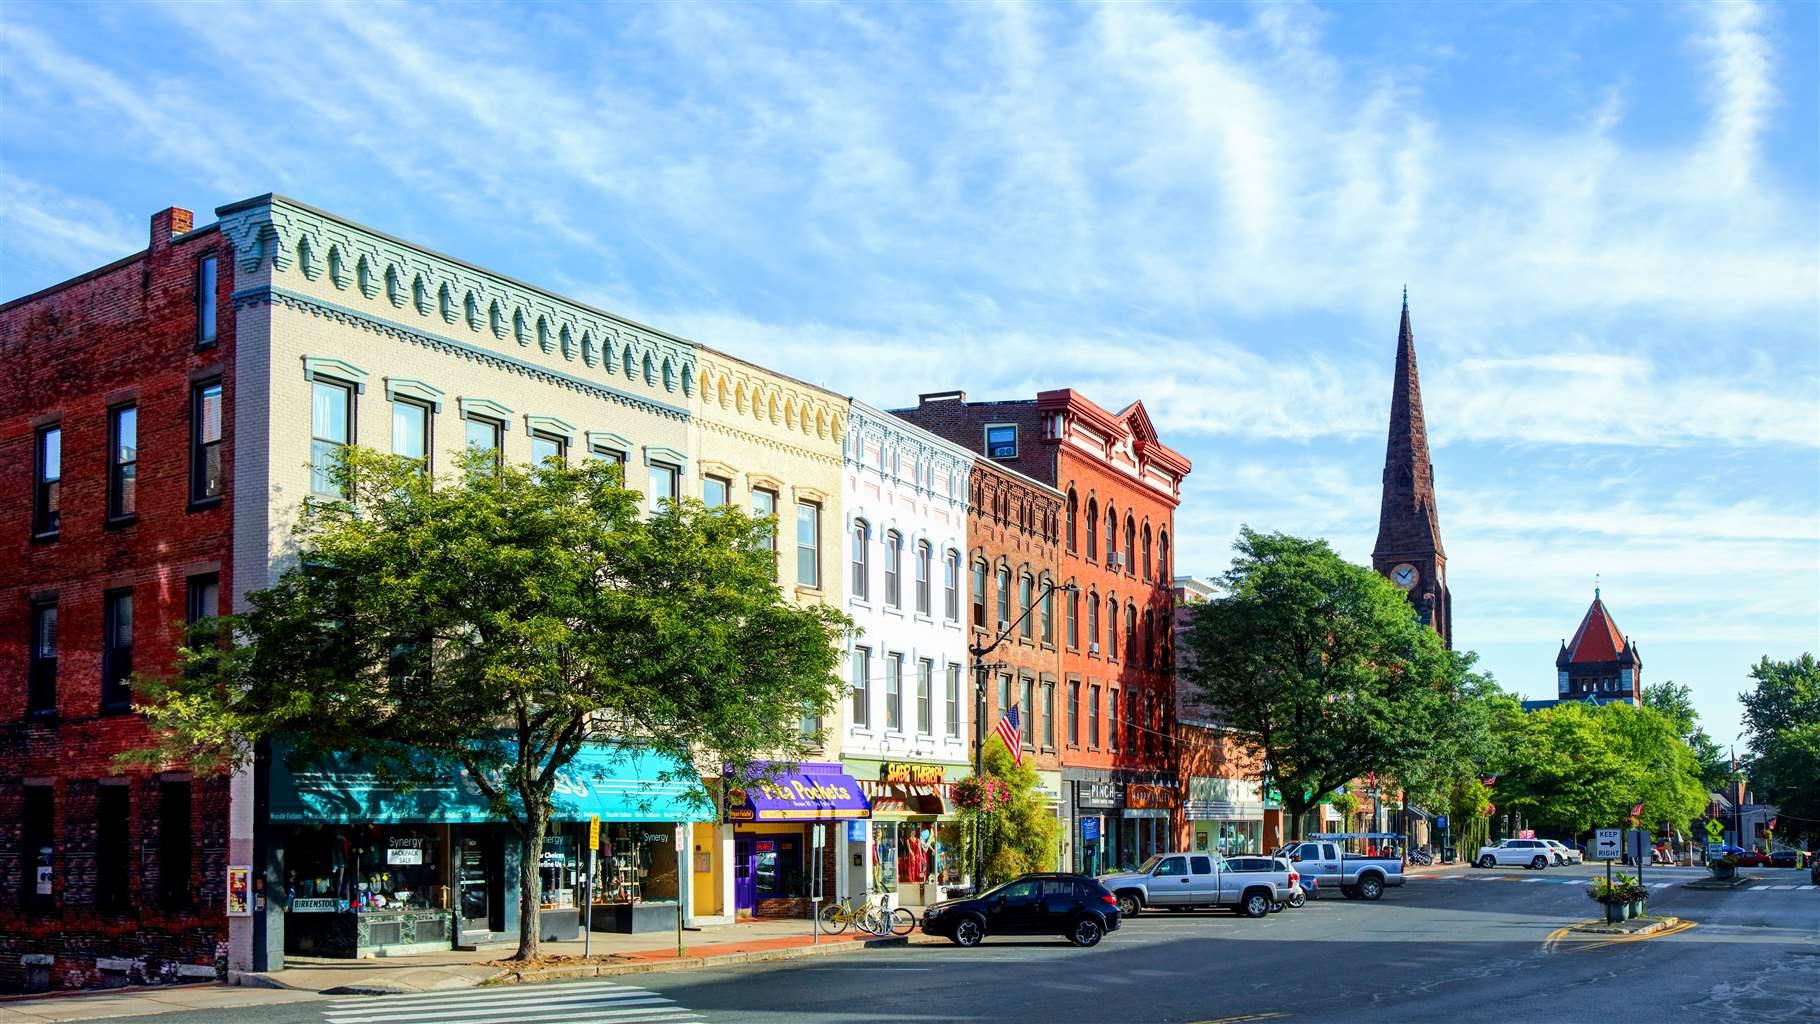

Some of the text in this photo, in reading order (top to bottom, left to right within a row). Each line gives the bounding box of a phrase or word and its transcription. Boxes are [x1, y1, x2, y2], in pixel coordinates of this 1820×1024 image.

[888, 763, 946, 783] SHOP THERAPY
[790, 780, 851, 800] Pockets
[1091, 785, 1114, 798] PINCH
[389, 836, 423, 848] Synergy
[544, 836, 564, 845] nergy
[643, 832, 669, 843] Synergy
[294, 900, 337, 908] BIRKENSTOCK
